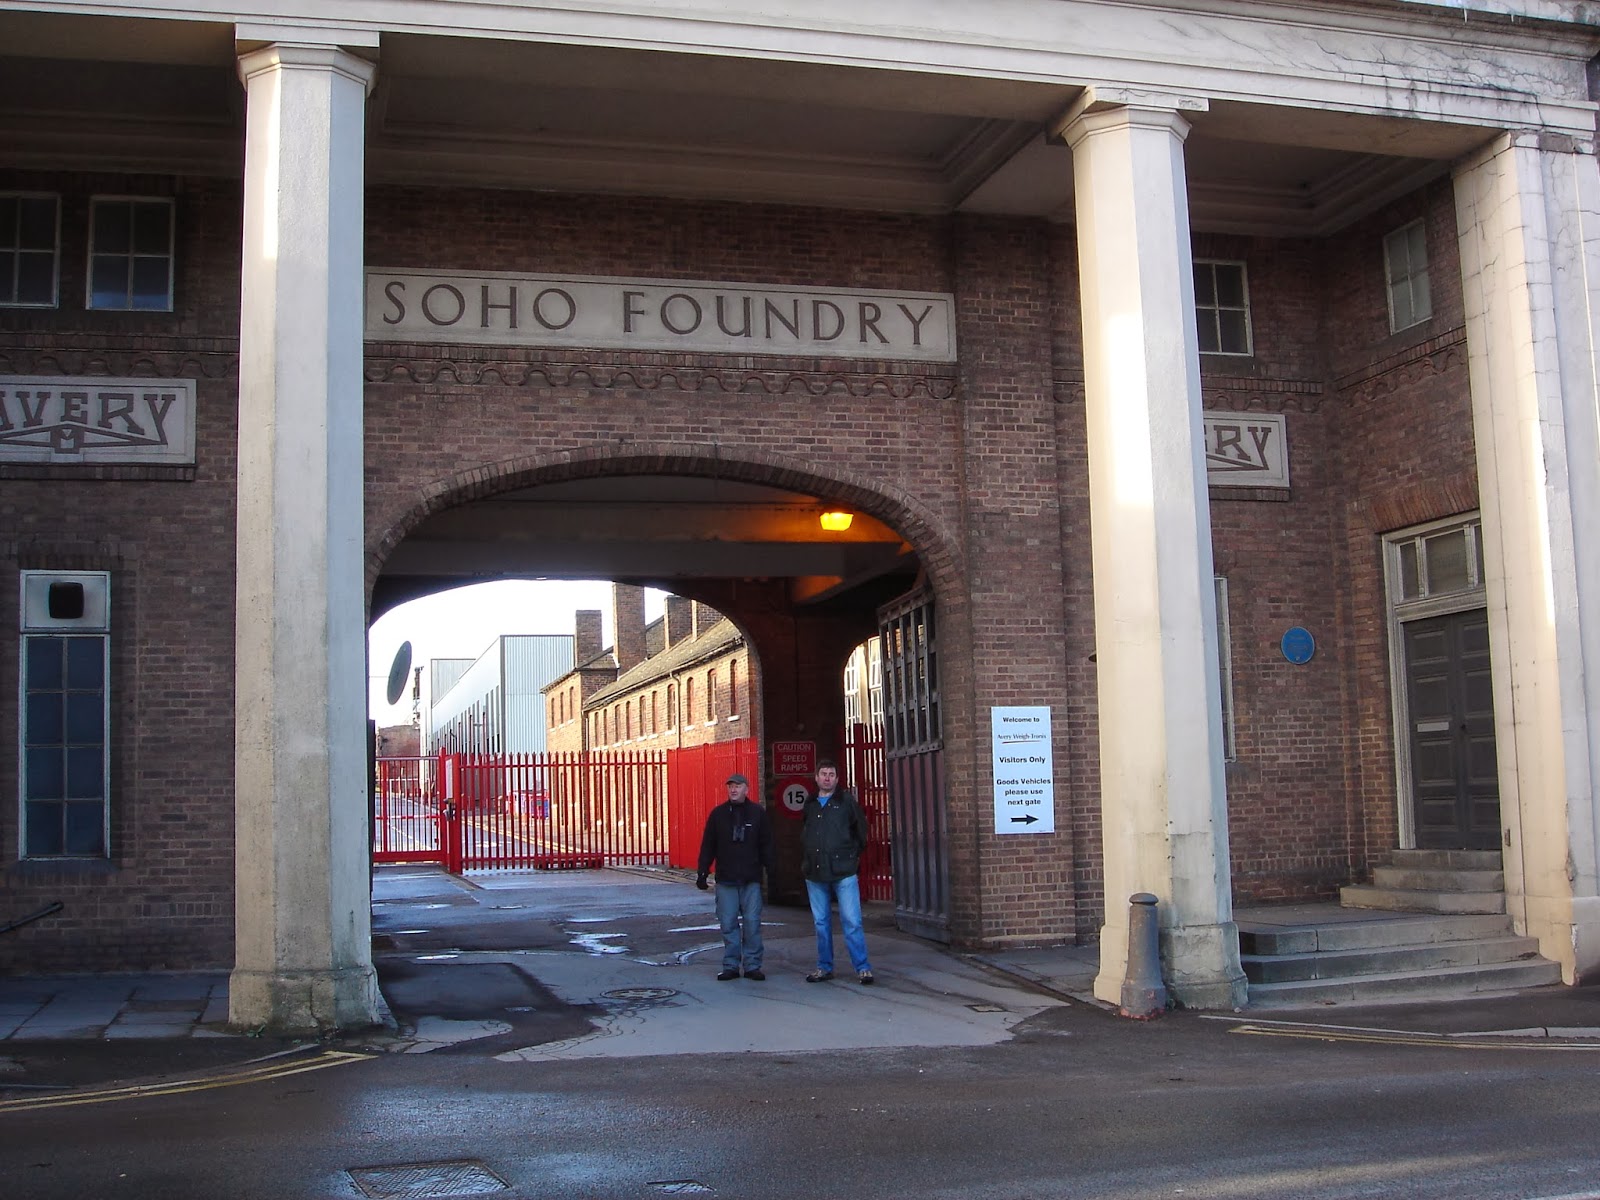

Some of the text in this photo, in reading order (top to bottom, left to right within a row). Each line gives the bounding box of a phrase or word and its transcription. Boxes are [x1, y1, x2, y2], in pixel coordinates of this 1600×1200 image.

[382, 281, 933, 345] SOHO FOUNDRY
[782, 754, 807, 762] SPEED
[1028, 756, 1046, 764] Only
[781, 764, 808, 772] RAMPS
[787, 791, 805, 804] 15
